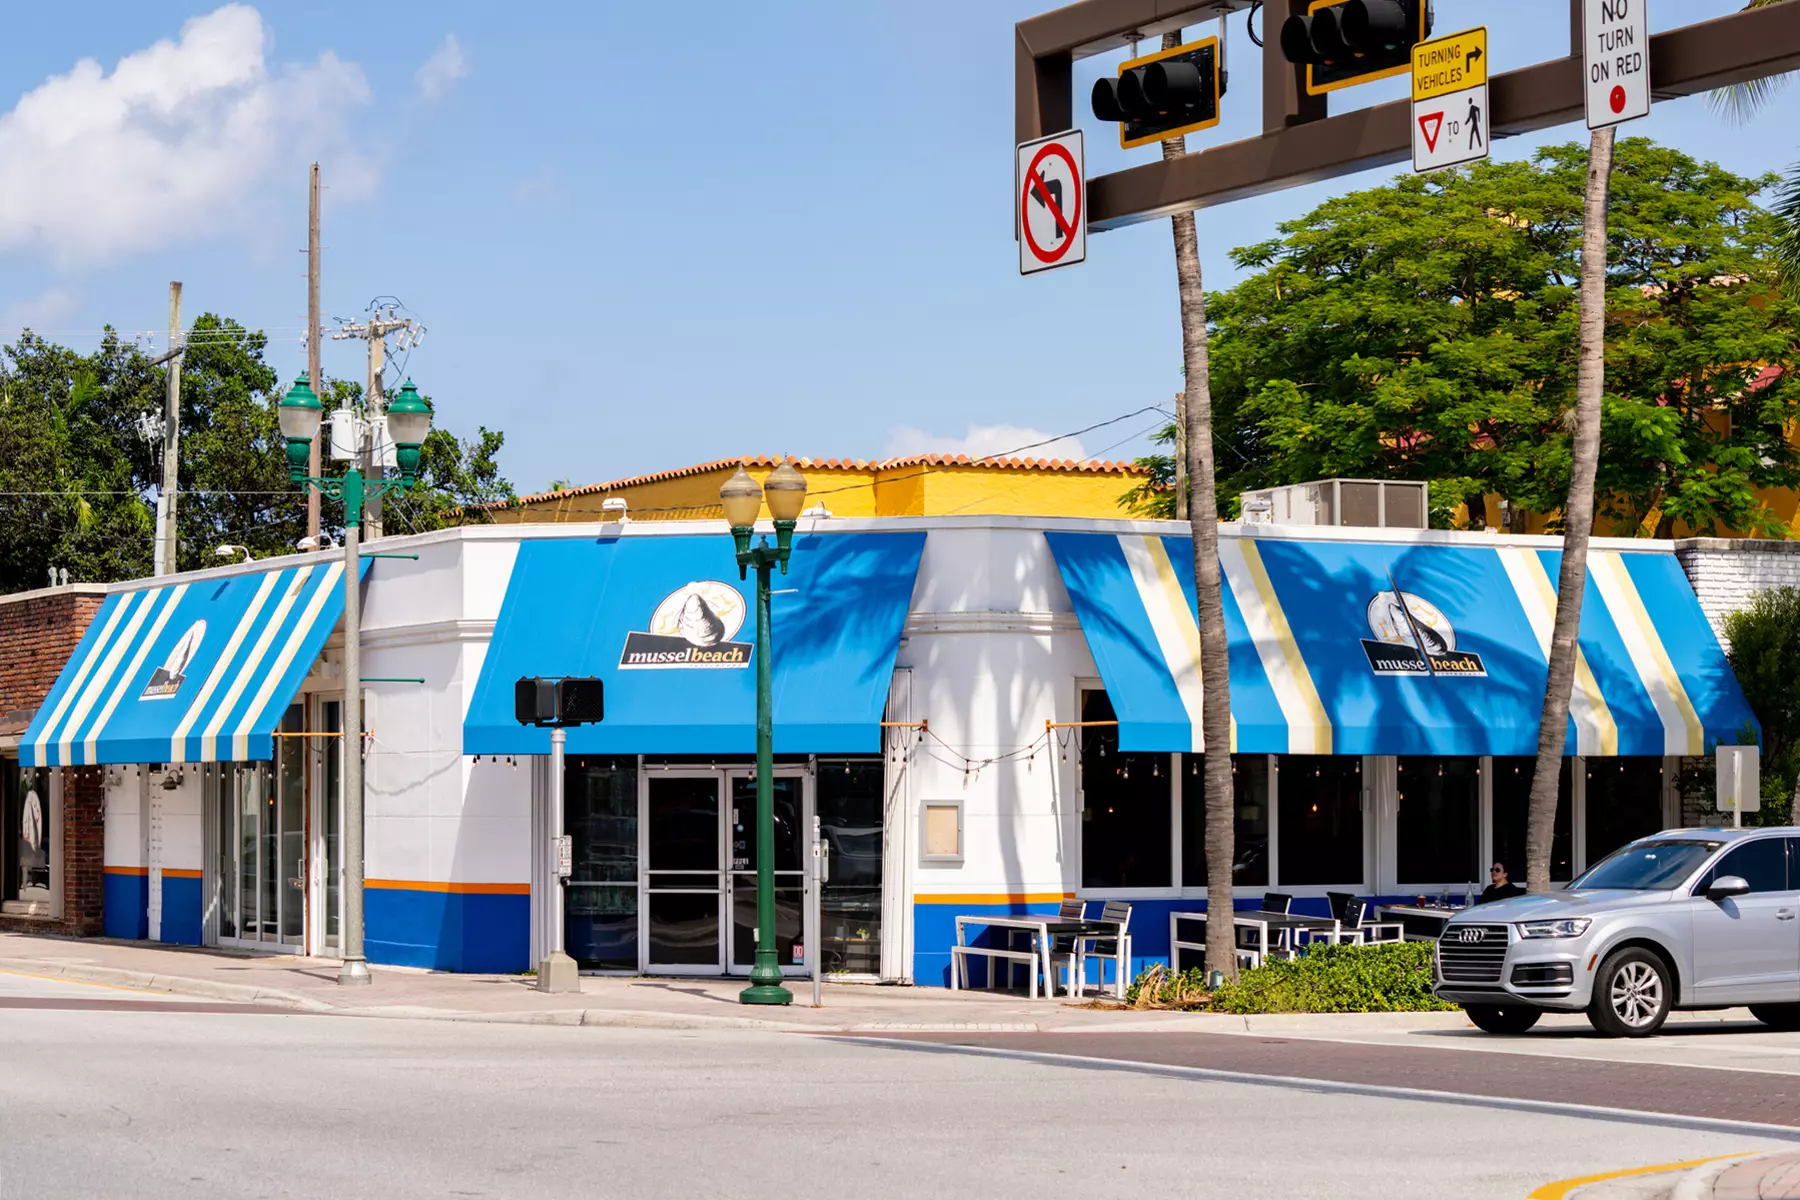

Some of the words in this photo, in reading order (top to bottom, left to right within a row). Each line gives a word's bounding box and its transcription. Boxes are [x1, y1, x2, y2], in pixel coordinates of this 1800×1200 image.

[1602, 0, 1628, 25] NO
[1598, 25, 1634, 53] TURN
[1418, 44, 1461, 69] TURNING
[1591, 60, 1610, 84] ON
[1616, 51, 1642, 77] RED
[1416, 68, 1462, 92] VEHICLES
[1447, 120, 1459, 136] TO
[627, 647, 744, 664] musselbeach
